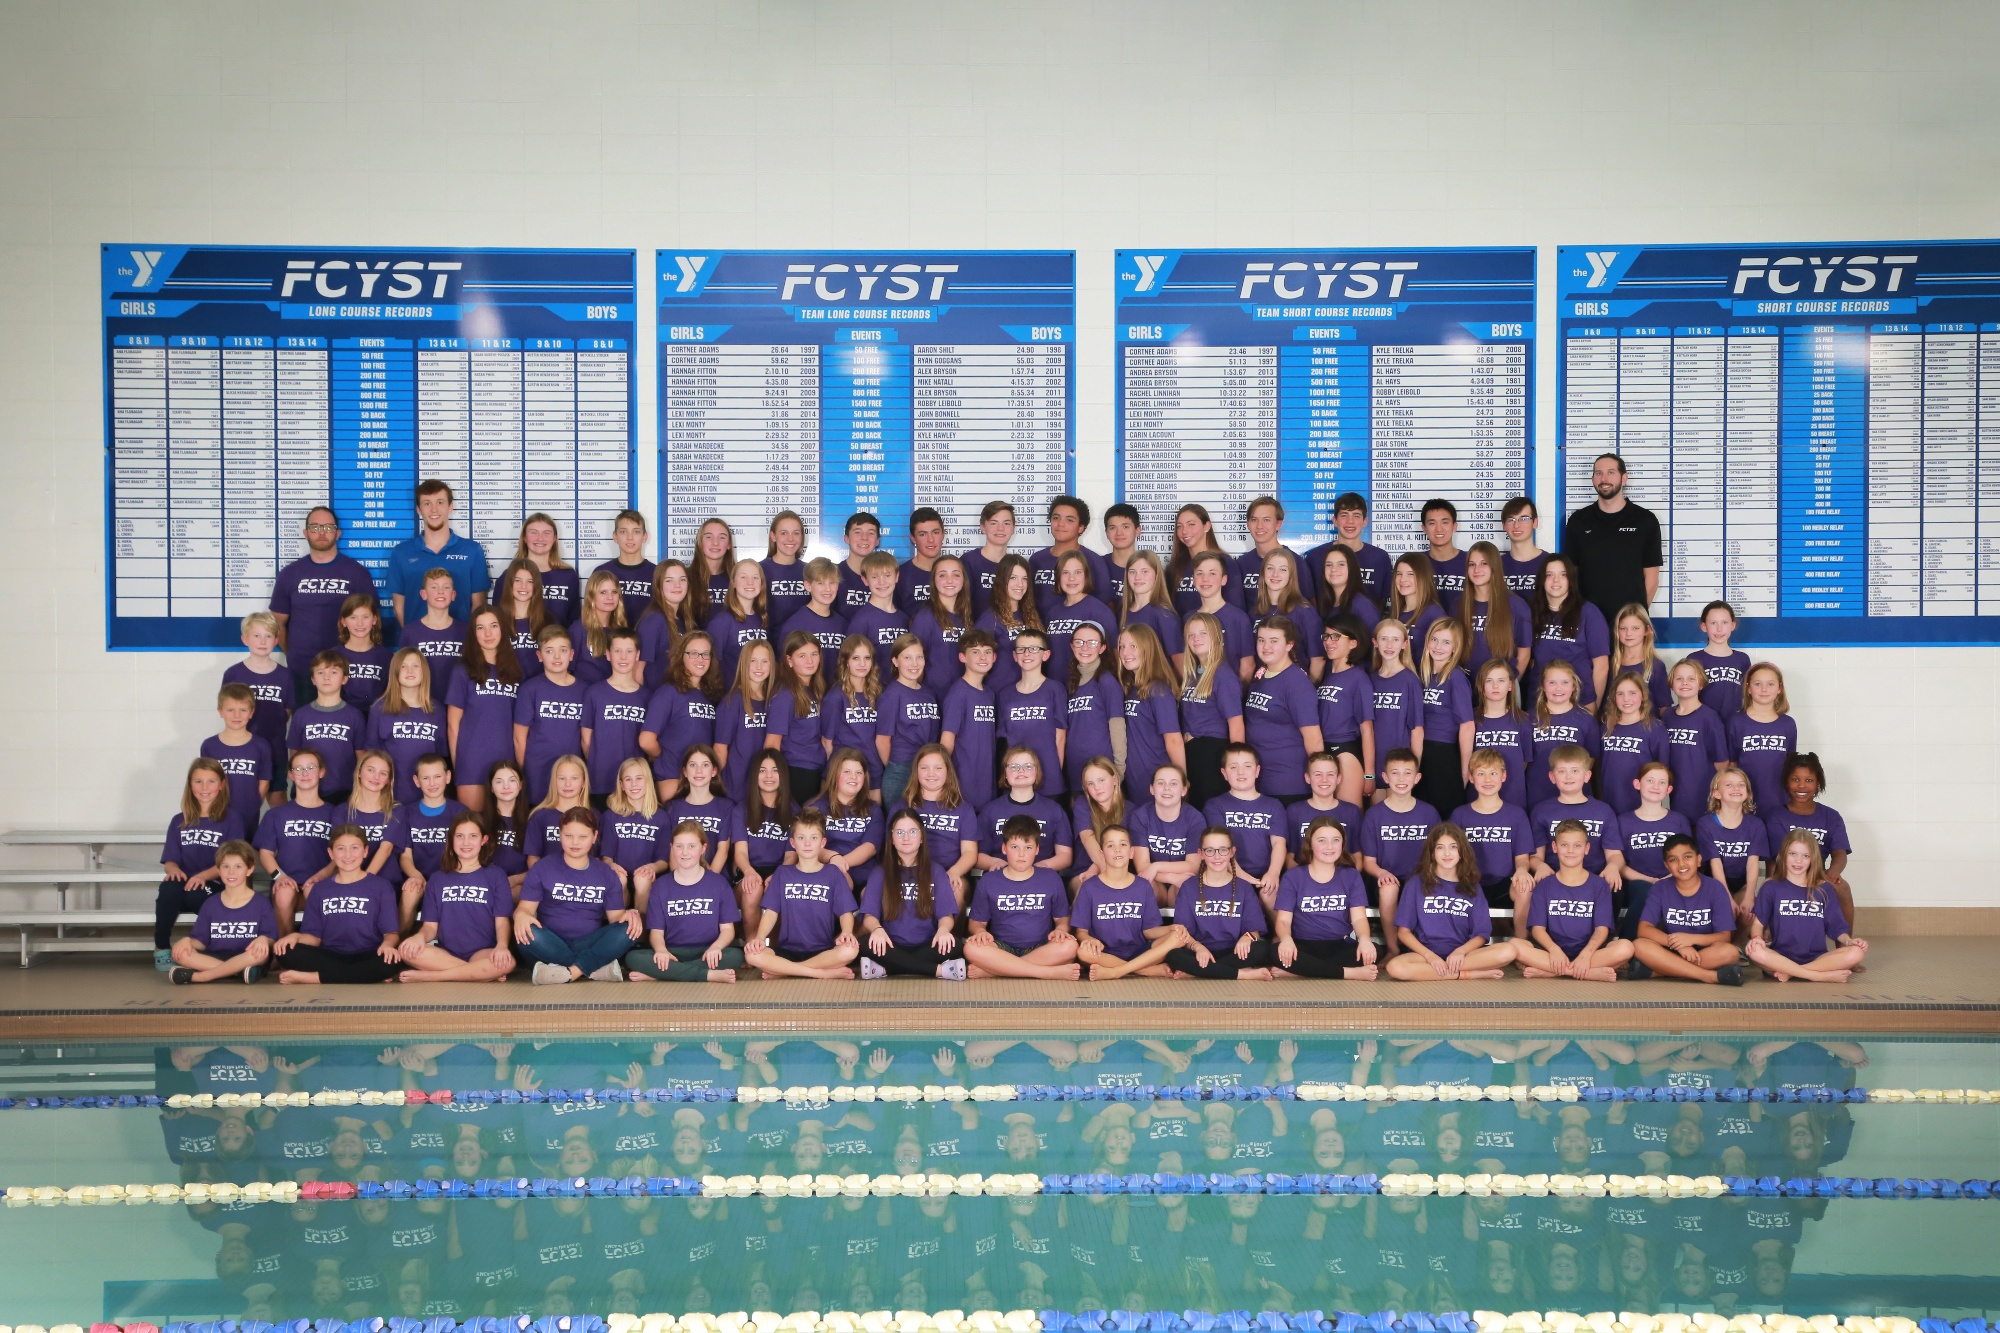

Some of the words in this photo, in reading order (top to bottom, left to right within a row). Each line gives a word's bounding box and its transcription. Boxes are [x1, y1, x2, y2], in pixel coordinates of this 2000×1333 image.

[117, 267, 133, 276] the
[662, 272, 678, 281] the
[1121, 272, 1136, 281] the
[1572, 268, 1588, 277] the
[1734, 256, 1918, 294] FCYST
[281, 260, 462, 298] FCYST
[782, 264, 959, 301] FCYST
[1240, 262, 1418, 299] FCYST
[120, 301, 156, 316] GIRLS
[308, 305, 337, 317] LONG
[339, 306, 381, 317] COURSE
[384, 306, 433, 318] RECORDS
[586, 305, 618, 319] BOYS
[1256, 307, 1280, 318] TEAM
[1282, 307, 1312, 318] SHORT
[1314, 307, 1350, 317] COURSE
[1352, 307, 1393, 317] RECORDS
[1574, 302, 1609, 316] GIRLS
[1757, 302, 1793, 313] SHORT
[1795, 301, 1838, 313] COURSE
[1841, 301, 1890, 312] RECORDS
[801, 309, 825, 319] TEAM
[827, 309, 851, 319] LONG
[853, 309, 888, 319] COURSE
[890, 309, 931, 319] RECORDS
[670, 326, 704, 340] GIRLS
[851, 330, 882, 341] EVENTS
[1031, 326, 1062, 340] BOYS
[1128, 325, 1163, 339] GIRLS
[1309, 328, 1340, 339] EVENTS
[1491, 323, 1523, 337] BOYS
[1813, 326, 1835, 335] EVENTS
[128, 336, 134, 345] 8
[135, 336, 143, 345] &
[143, 336, 150, 345] U
[181, 337, 187, 346] 9
[188, 337, 195, 346] &
[197, 337, 207, 346] 10
[233, 337, 243, 346] 11
[244, 337, 252, 346] &
[253, 337, 263, 347] 12
[288, 337, 298, 347] 13
[298, 338, 306, 347] &
[307, 338, 317, 347] 14
[359, 338, 385, 347] EVENTS
[372, 362, 386, 370] FREE
[1310, 378, 1324, 386] 500
[1324, 378, 1339, 386] FREE
[359, 401, 375, 409] 1500
[374, 401, 388, 409] FREE
[851, 399, 868, 408] 1500
[867, 399, 883, 408] FREE
[856, 474, 866, 482] 50
[866, 474, 877, 482] FLY
[298, 578, 350, 590] FCYST
[418, 641, 464, 653] FCYST
[604, 704, 646, 716] FCYST
[1010, 707, 1047, 717] FCYST
[305, 723, 350, 736] FCYST
[1742, 735, 1787, 747] FCYST
[1225, 811, 1272, 824] FCYST
[284, 820, 331, 835] FCYST
[614, 823, 659, 836] FCYST
[1380, 824, 1428, 836] FCYST
[1466, 826, 1512, 838] FCYST
[441, 886, 488, 898] FCYST
[552, 883, 606, 897] FCYST
[785, 883, 830, 896] FCYST
[322, 897, 369, 910] FCYST
[667, 899, 712, 912] FCYST
[997, 894, 1047, 906] FCYST
[1301, 896, 1347, 908] FCYST
[1424, 896, 1473, 909] FCYST
[1549, 899, 1594, 911] FCYST
[1780, 899, 1825, 912] FCYST
[1097, 902, 1142, 915] FCYST
[1666, 908, 1711, 921] FCYST
[210, 922, 257, 934] FCYST
